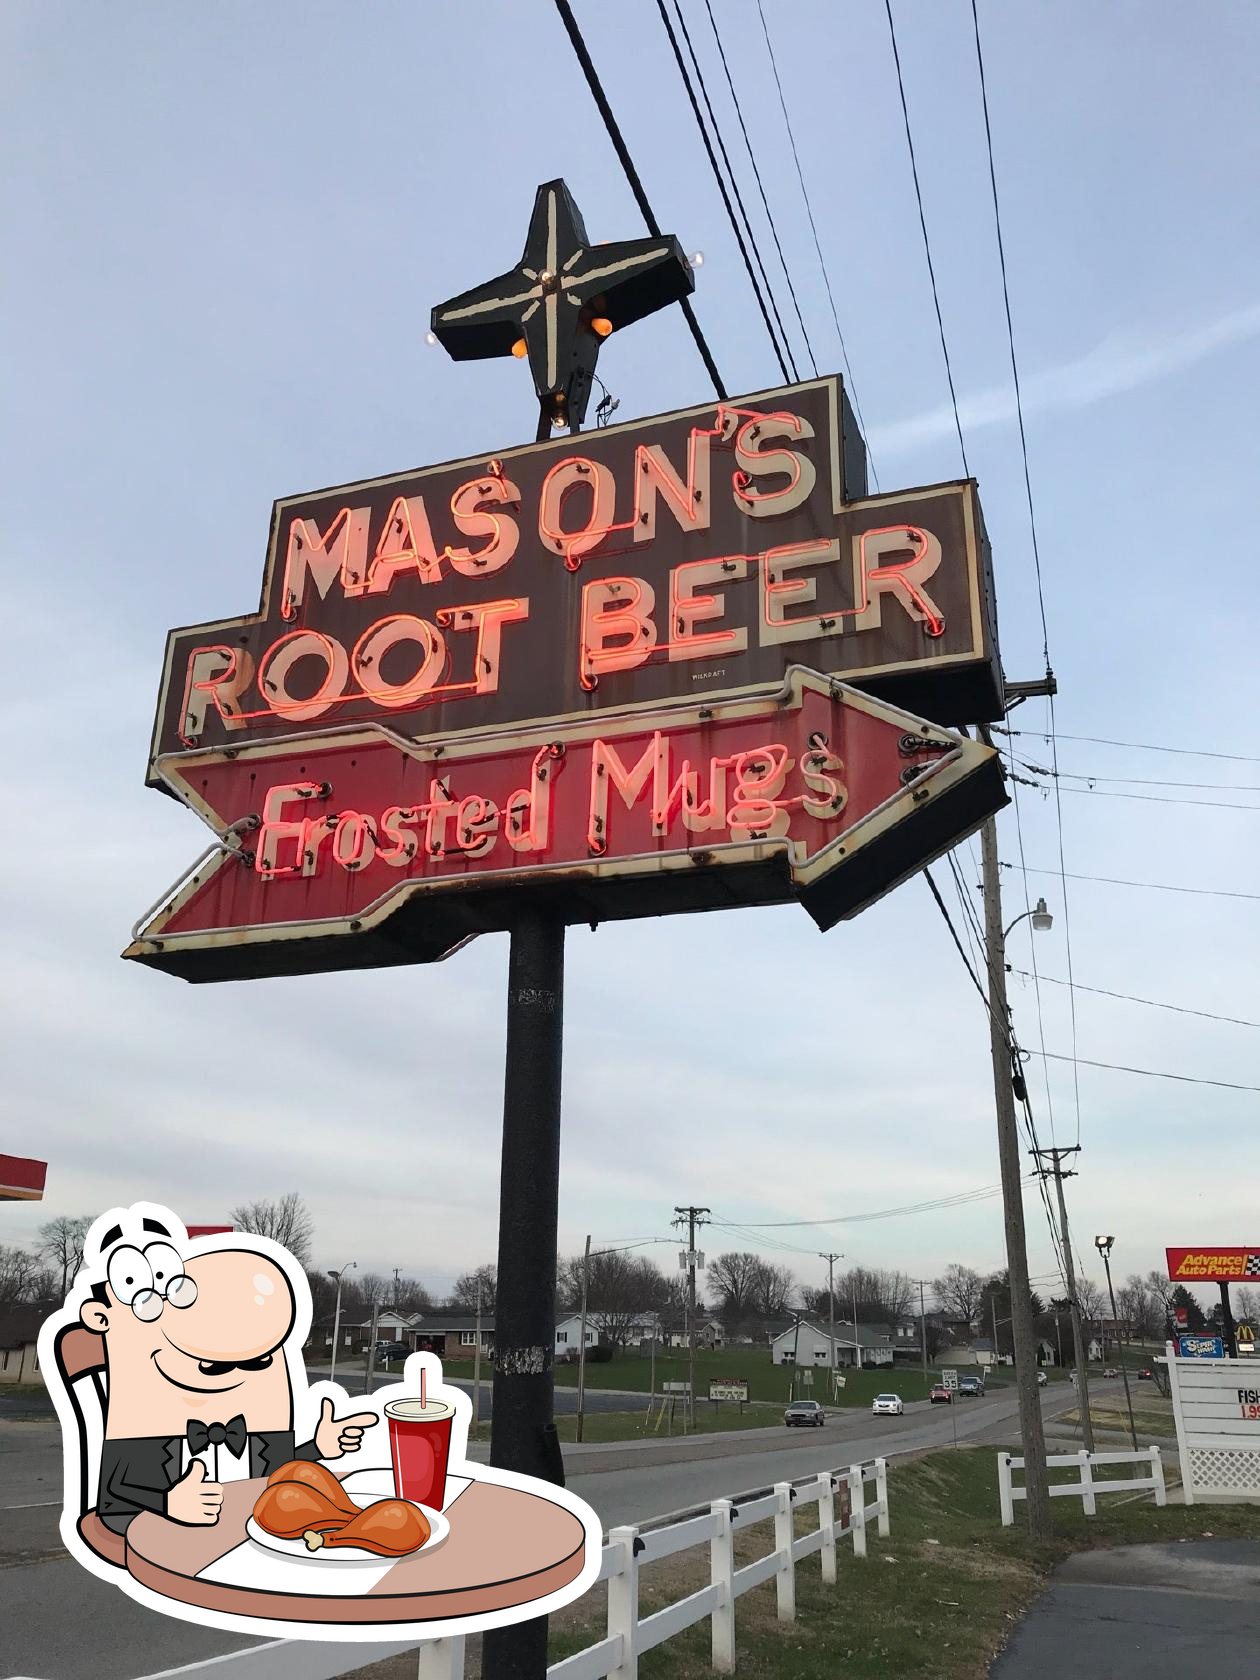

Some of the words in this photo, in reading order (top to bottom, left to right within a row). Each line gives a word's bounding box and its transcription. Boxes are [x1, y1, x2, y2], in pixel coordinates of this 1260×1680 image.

[282, 404, 817, 618] MASON'S
[179, 597, 530, 745] ROOT
[580, 524, 945, 688] BEER
[256, 745, 564, 881] Frosted
[588, 731, 849, 850] Mugs
[1176, 1264, 1207, 1275] Auto
[1207, 1264, 1241, 1275] Parts
[1182, 1254, 1243, 1265] Advance
[944, 1380, 957, 1389] 35
